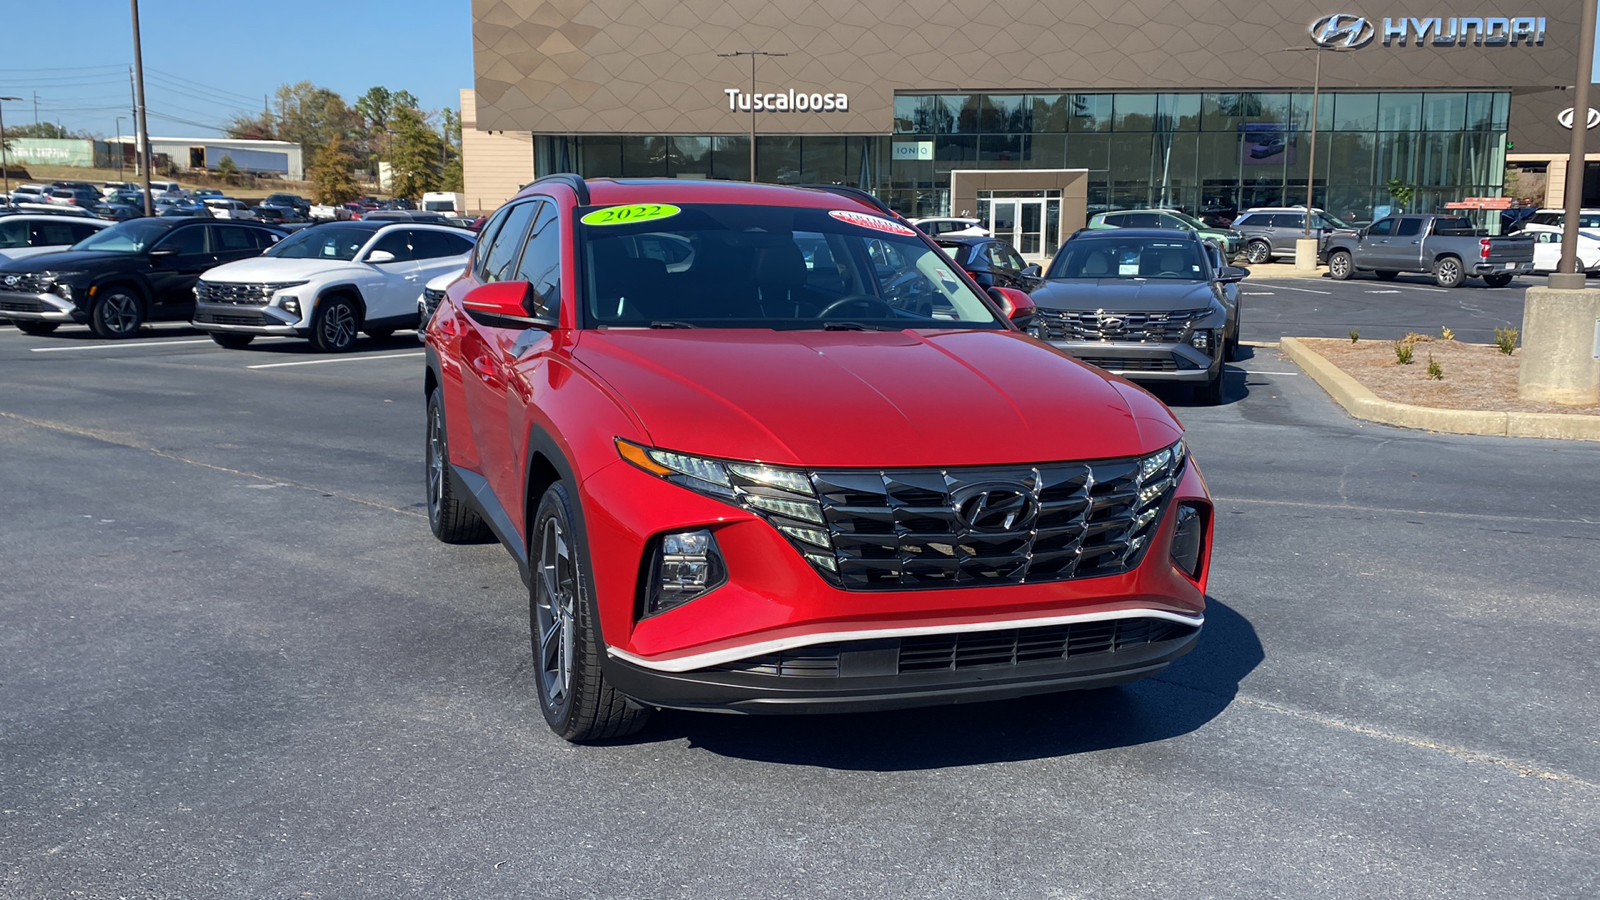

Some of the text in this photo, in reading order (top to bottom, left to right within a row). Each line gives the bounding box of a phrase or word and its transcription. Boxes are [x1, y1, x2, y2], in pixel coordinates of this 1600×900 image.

[1382, 16, 1547, 47] HYUNDAI
[724, 88, 848, 112] Tuscaloosa
[896, 146, 928, 155] IONIQ
[600, 205, 662, 223] 2022
